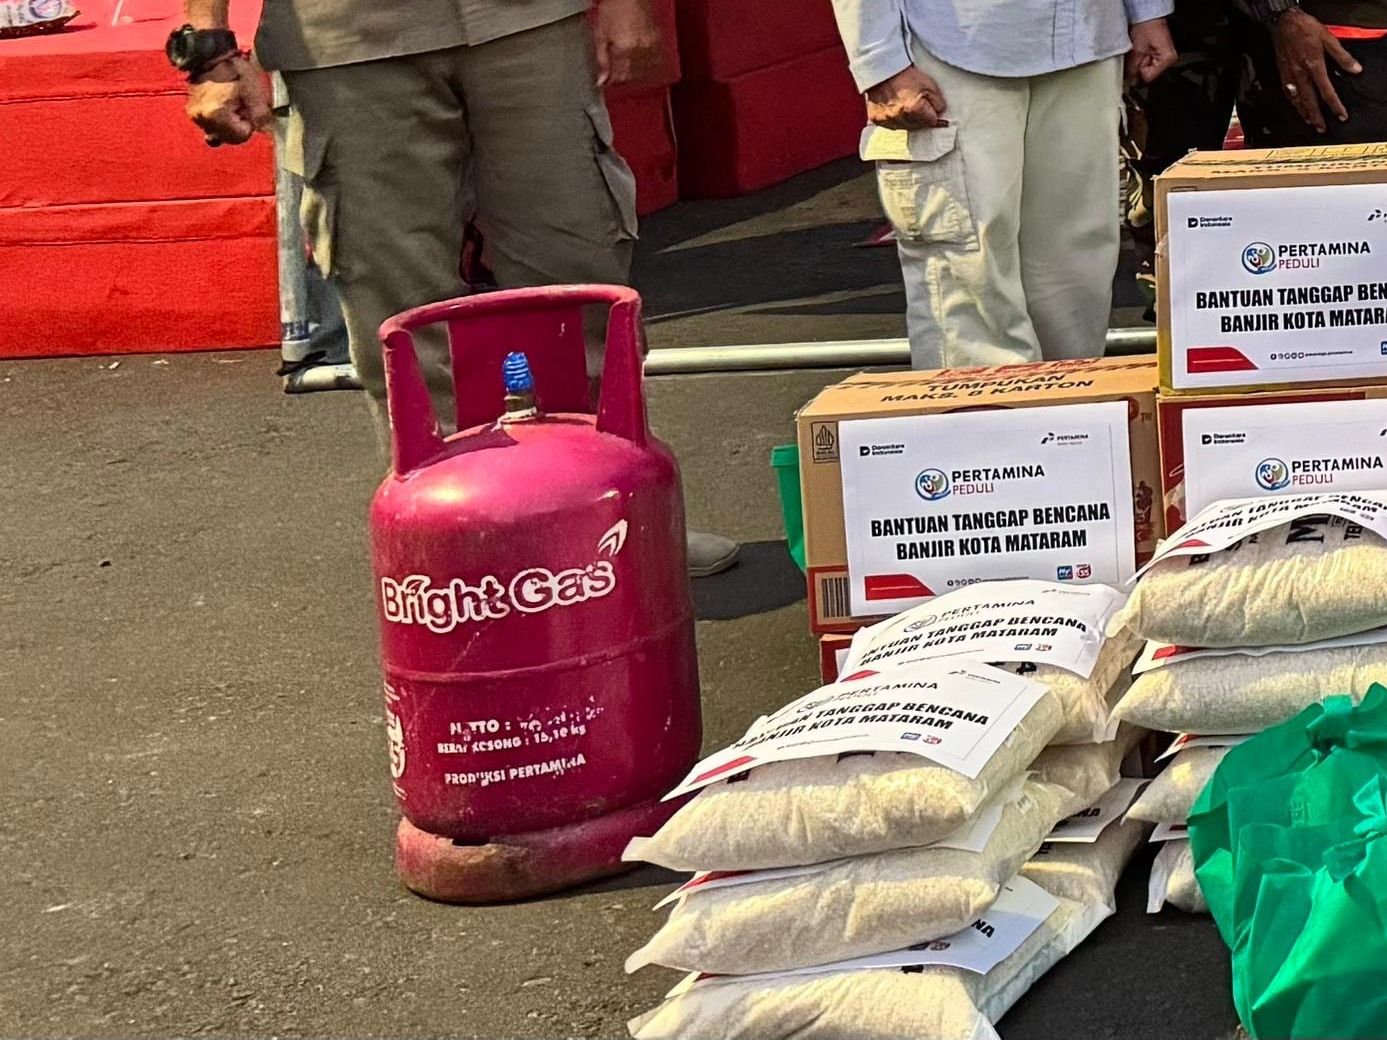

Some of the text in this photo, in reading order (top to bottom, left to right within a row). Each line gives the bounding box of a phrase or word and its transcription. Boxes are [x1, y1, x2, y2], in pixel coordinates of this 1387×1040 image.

[1278, 241, 1371, 257] PERTAMINA
[1278, 258, 1320, 270] PEDULI
[1196, 288, 1274, 309] BANTUAN
[1277, 285, 1354, 306] TANGGAP
[1220, 313, 1279, 333] BANJIR
[1283, 310, 1326, 330] KOTA
[928, 374, 1066, 392] TUMPUKAN
[991, 380, 1094, 396] KARTON
[951, 465, 1045, 482] PERTAMINA
[1292, 457, 1383, 473] PERTAMINA
[1292, 473, 1333, 485] PEDULI
[952, 483, 994, 495] PEDULI
[871, 503, 1110, 537] BANTUAN TANGGAP BENCANA
[896, 529, 1087, 560] BANJIR KOTA MATARAM
[381, 561, 616, 633] Bright Gas
[941, 599, 1036, 617] PERTAMINA
[816, 702, 989, 726] TANGGAP BENCANA
[858, 714, 953, 730] MATARAM
